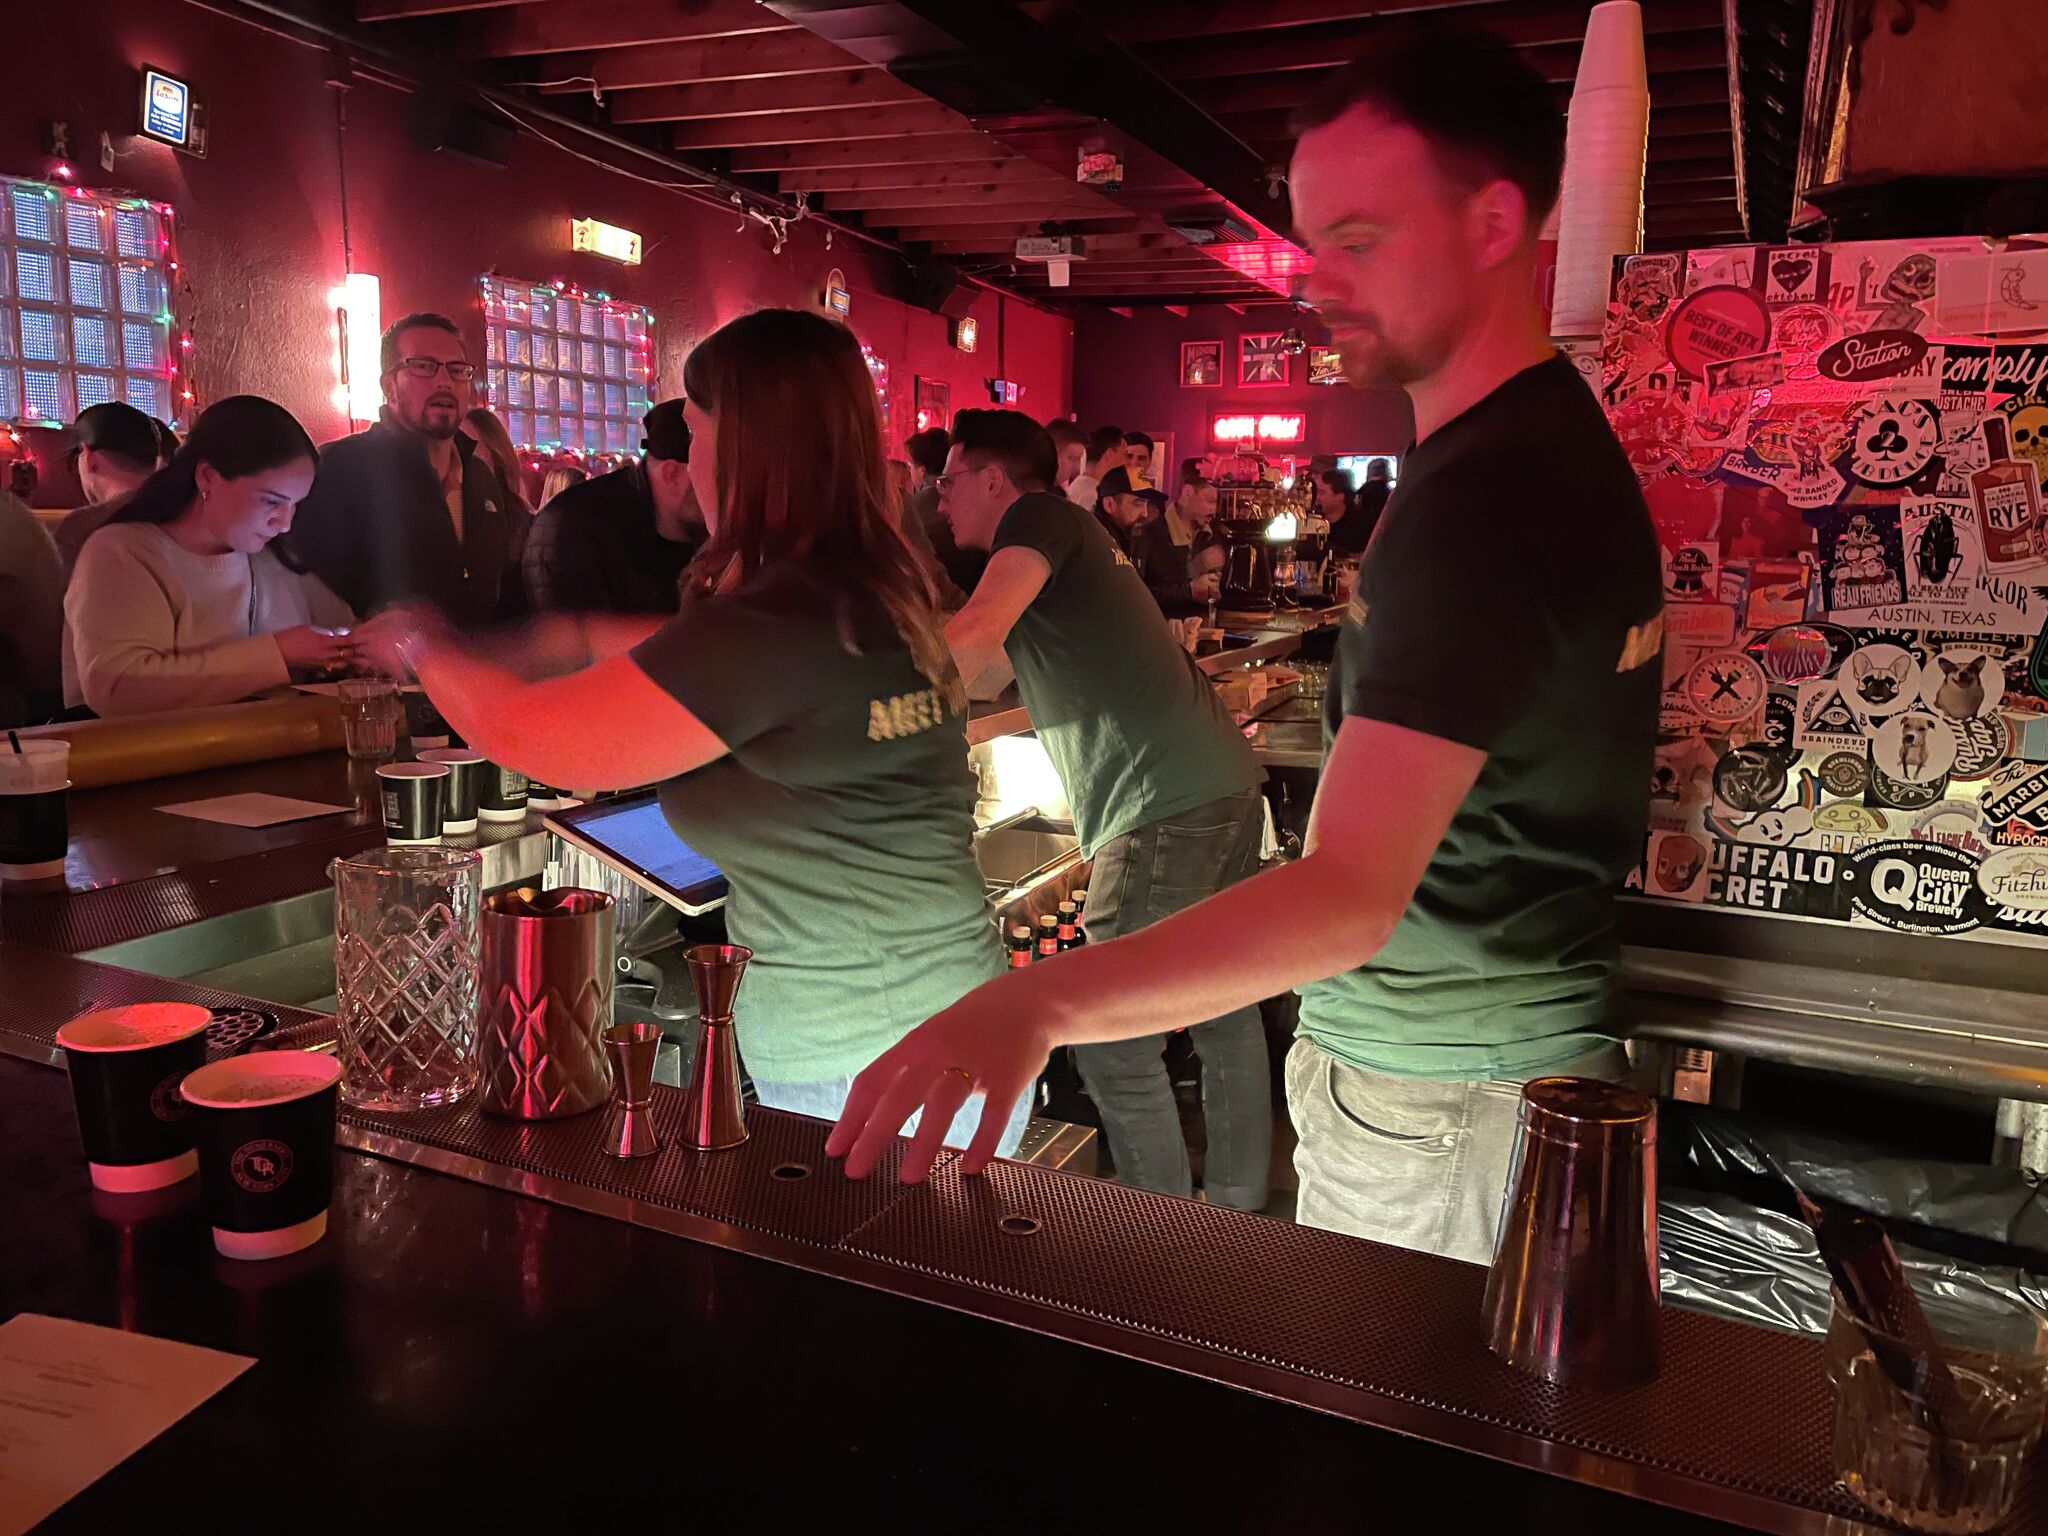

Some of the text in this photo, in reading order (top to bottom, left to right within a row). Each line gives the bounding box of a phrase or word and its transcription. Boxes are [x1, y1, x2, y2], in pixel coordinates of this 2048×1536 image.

[1771, 250, 1818, 261] secret
[1684, 309, 1717, 330] BEST
[1716, 322, 1735, 338] OF
[1733, 329, 1760, 348] ATX
[1187, 345, 1217, 364] MIDORI
[1688, 328, 1739, 358] WINNER
[1832, 339, 1912, 378] Station
[1942, 348, 2048, 397] comply
[1881, 431, 1897, 448] 2
[1793, 492, 1828, 502] WHISKEY
[1805, 478, 1838, 494] BANDED
[1904, 502, 1976, 525] AUSTIN
[1989, 502, 2030, 528] RYE
[1860, 582, 1901, 605] FRIENDS
[1975, 575, 2028, 615] KLOR
[1867, 608, 1997, 626] AUSTIN, TEXAS
[1969, 719, 1998, 757] Tap
[1992, 761, 2026, 787] The
[1711, 842, 1835, 884] UFFALO
[1852, 842, 1902, 863] World-class
[1902, 842, 1924, 851] beer
[1924, 843, 1958, 859] without
[1957, 852, 1973, 865] the
[1871, 858, 1918, 912] Q
[1919, 863, 1970, 884] Queen
[1704, 871, 1789, 909] CRET
[1916, 878, 1969, 907] City
[1851, 896, 1981, 934] Pine Street Burlington, Vermont
[1916, 900, 1964, 919] Brewery
